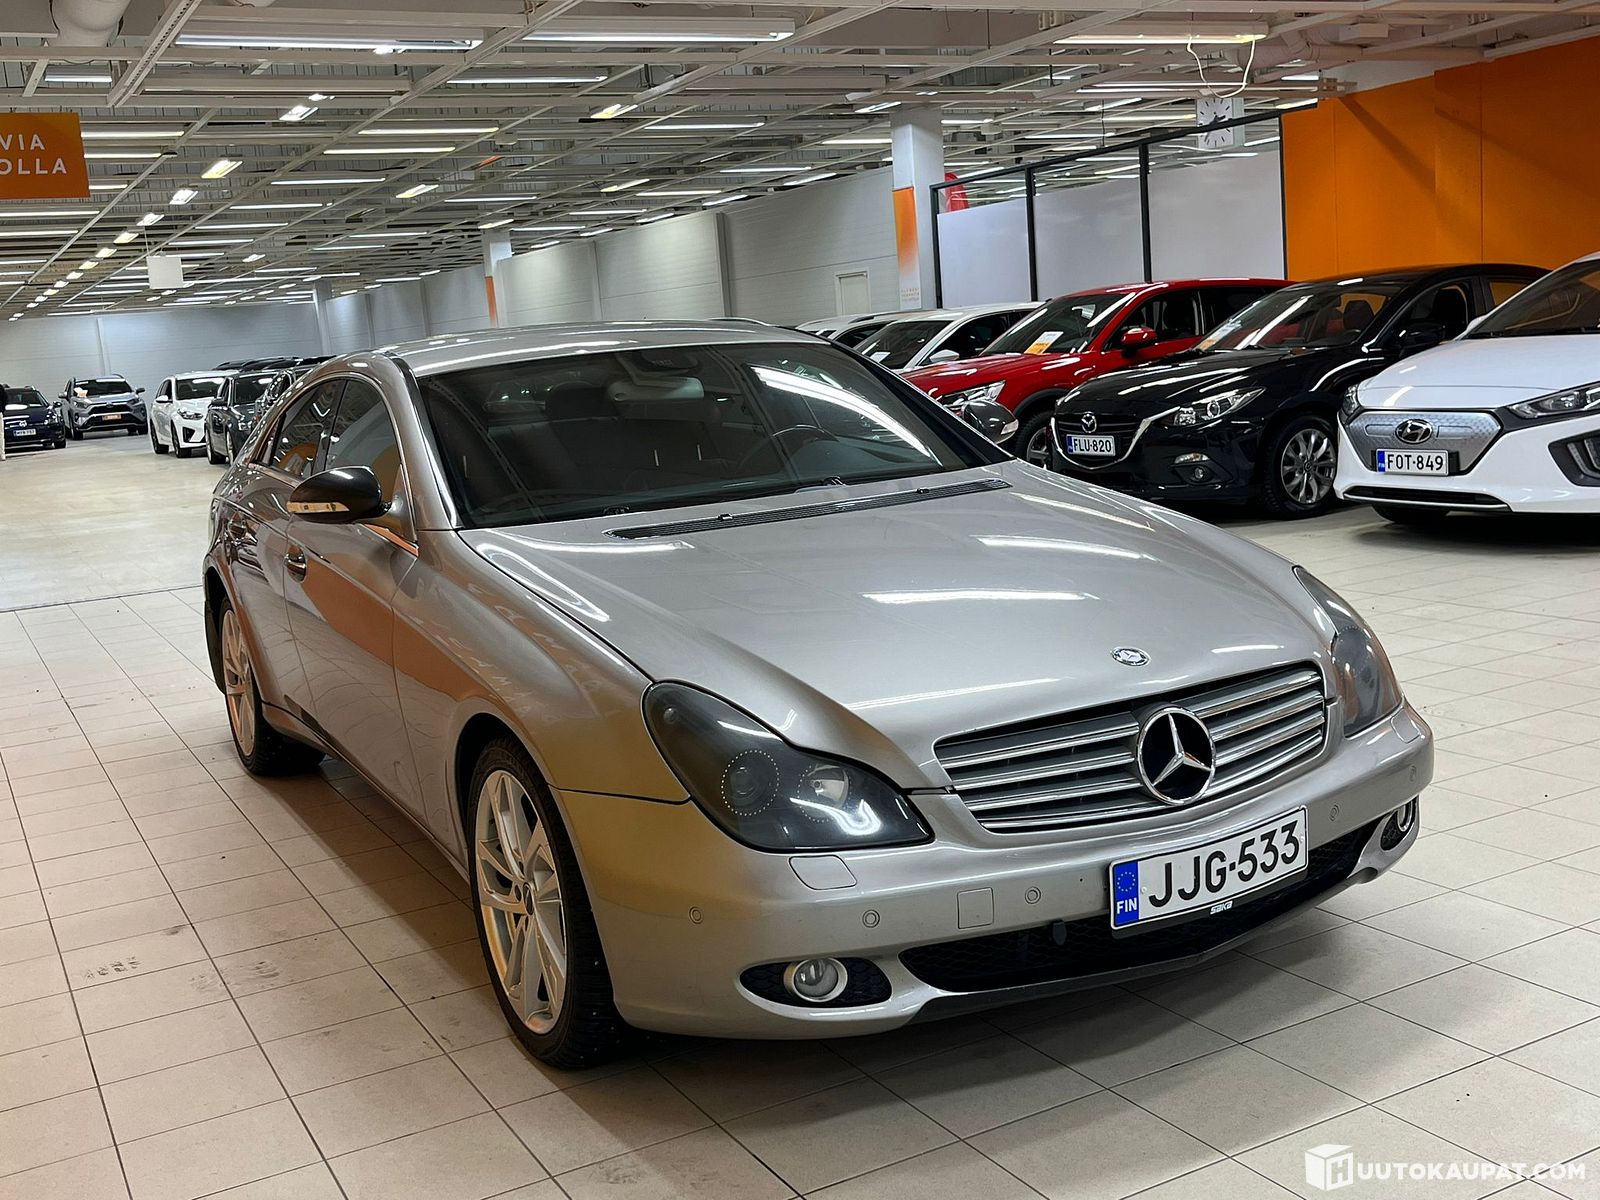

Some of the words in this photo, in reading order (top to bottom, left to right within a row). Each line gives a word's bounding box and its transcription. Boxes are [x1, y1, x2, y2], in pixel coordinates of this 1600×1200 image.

[0, 134, 45, 151] VIA
[0, 158, 67, 176] OLLA
[1073, 438, 1112, 453] FLU-820
[1387, 453, 1444, 471] FOT-849
[1148, 819, 1300, 908] JJG-533
[1116, 897, 1137, 915] FIN
